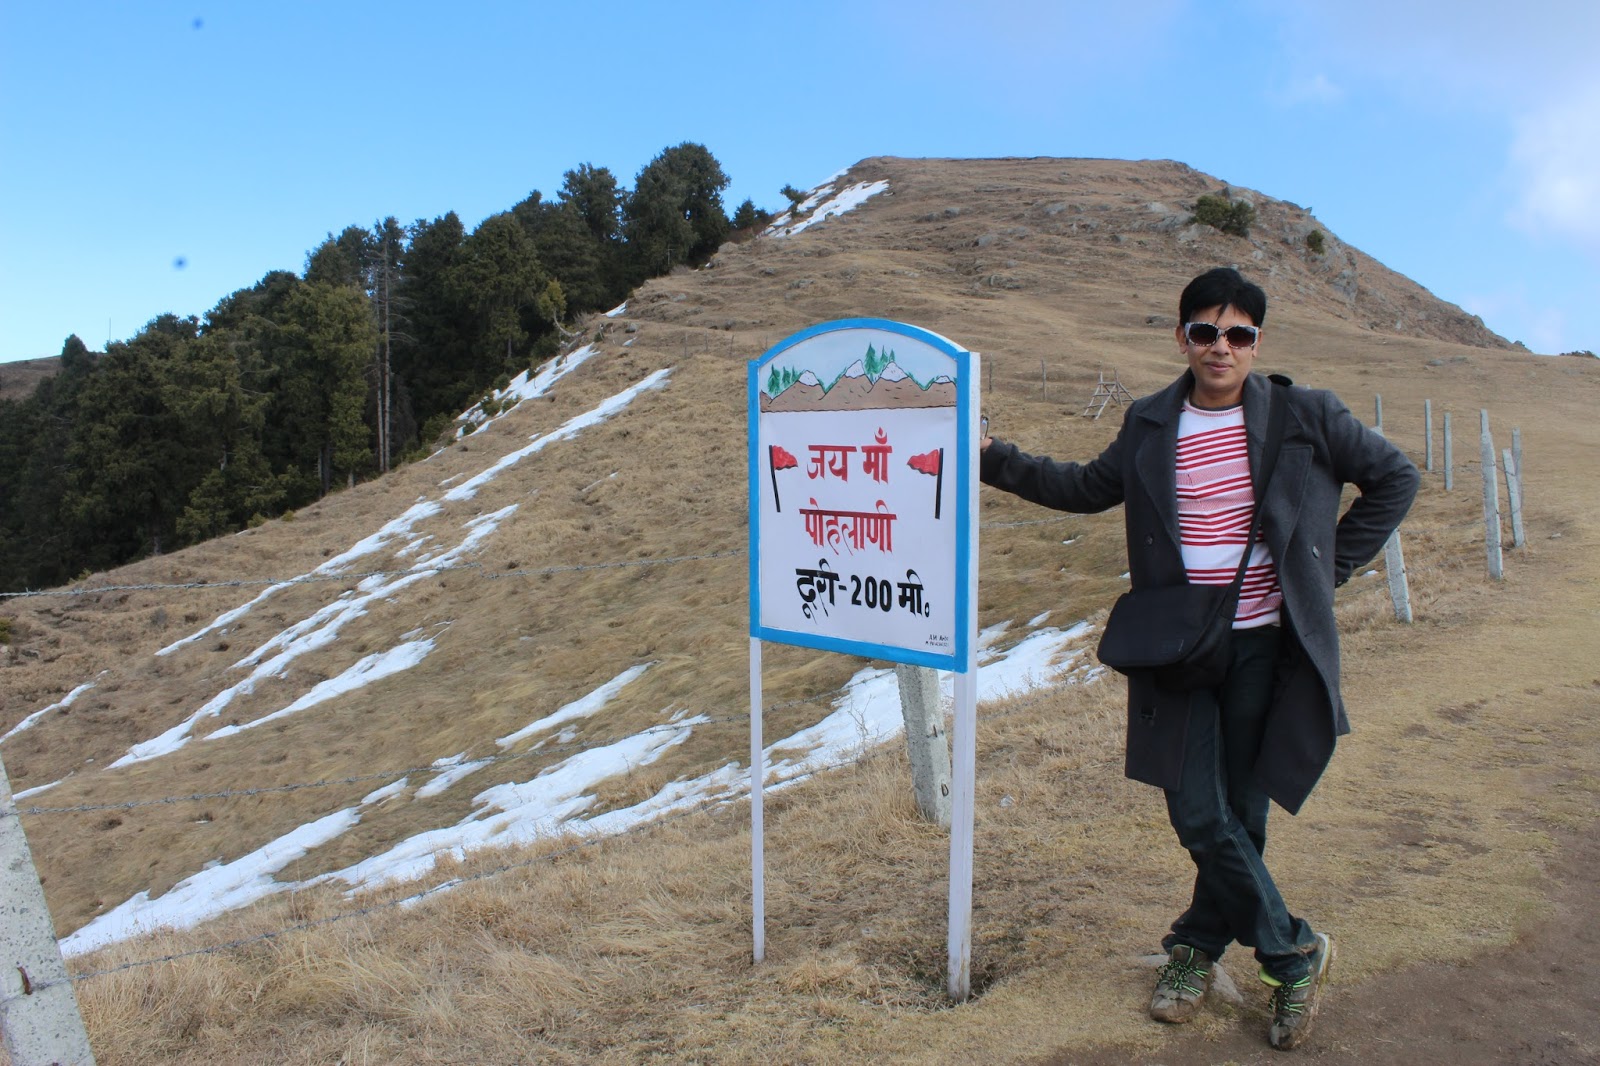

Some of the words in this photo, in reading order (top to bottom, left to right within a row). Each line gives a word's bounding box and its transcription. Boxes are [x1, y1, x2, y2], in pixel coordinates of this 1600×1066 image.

[807, 444, 857, 482] जय
[861, 427, 892, 483] माँ
[799, 497, 897, 556] पोहलाणी
